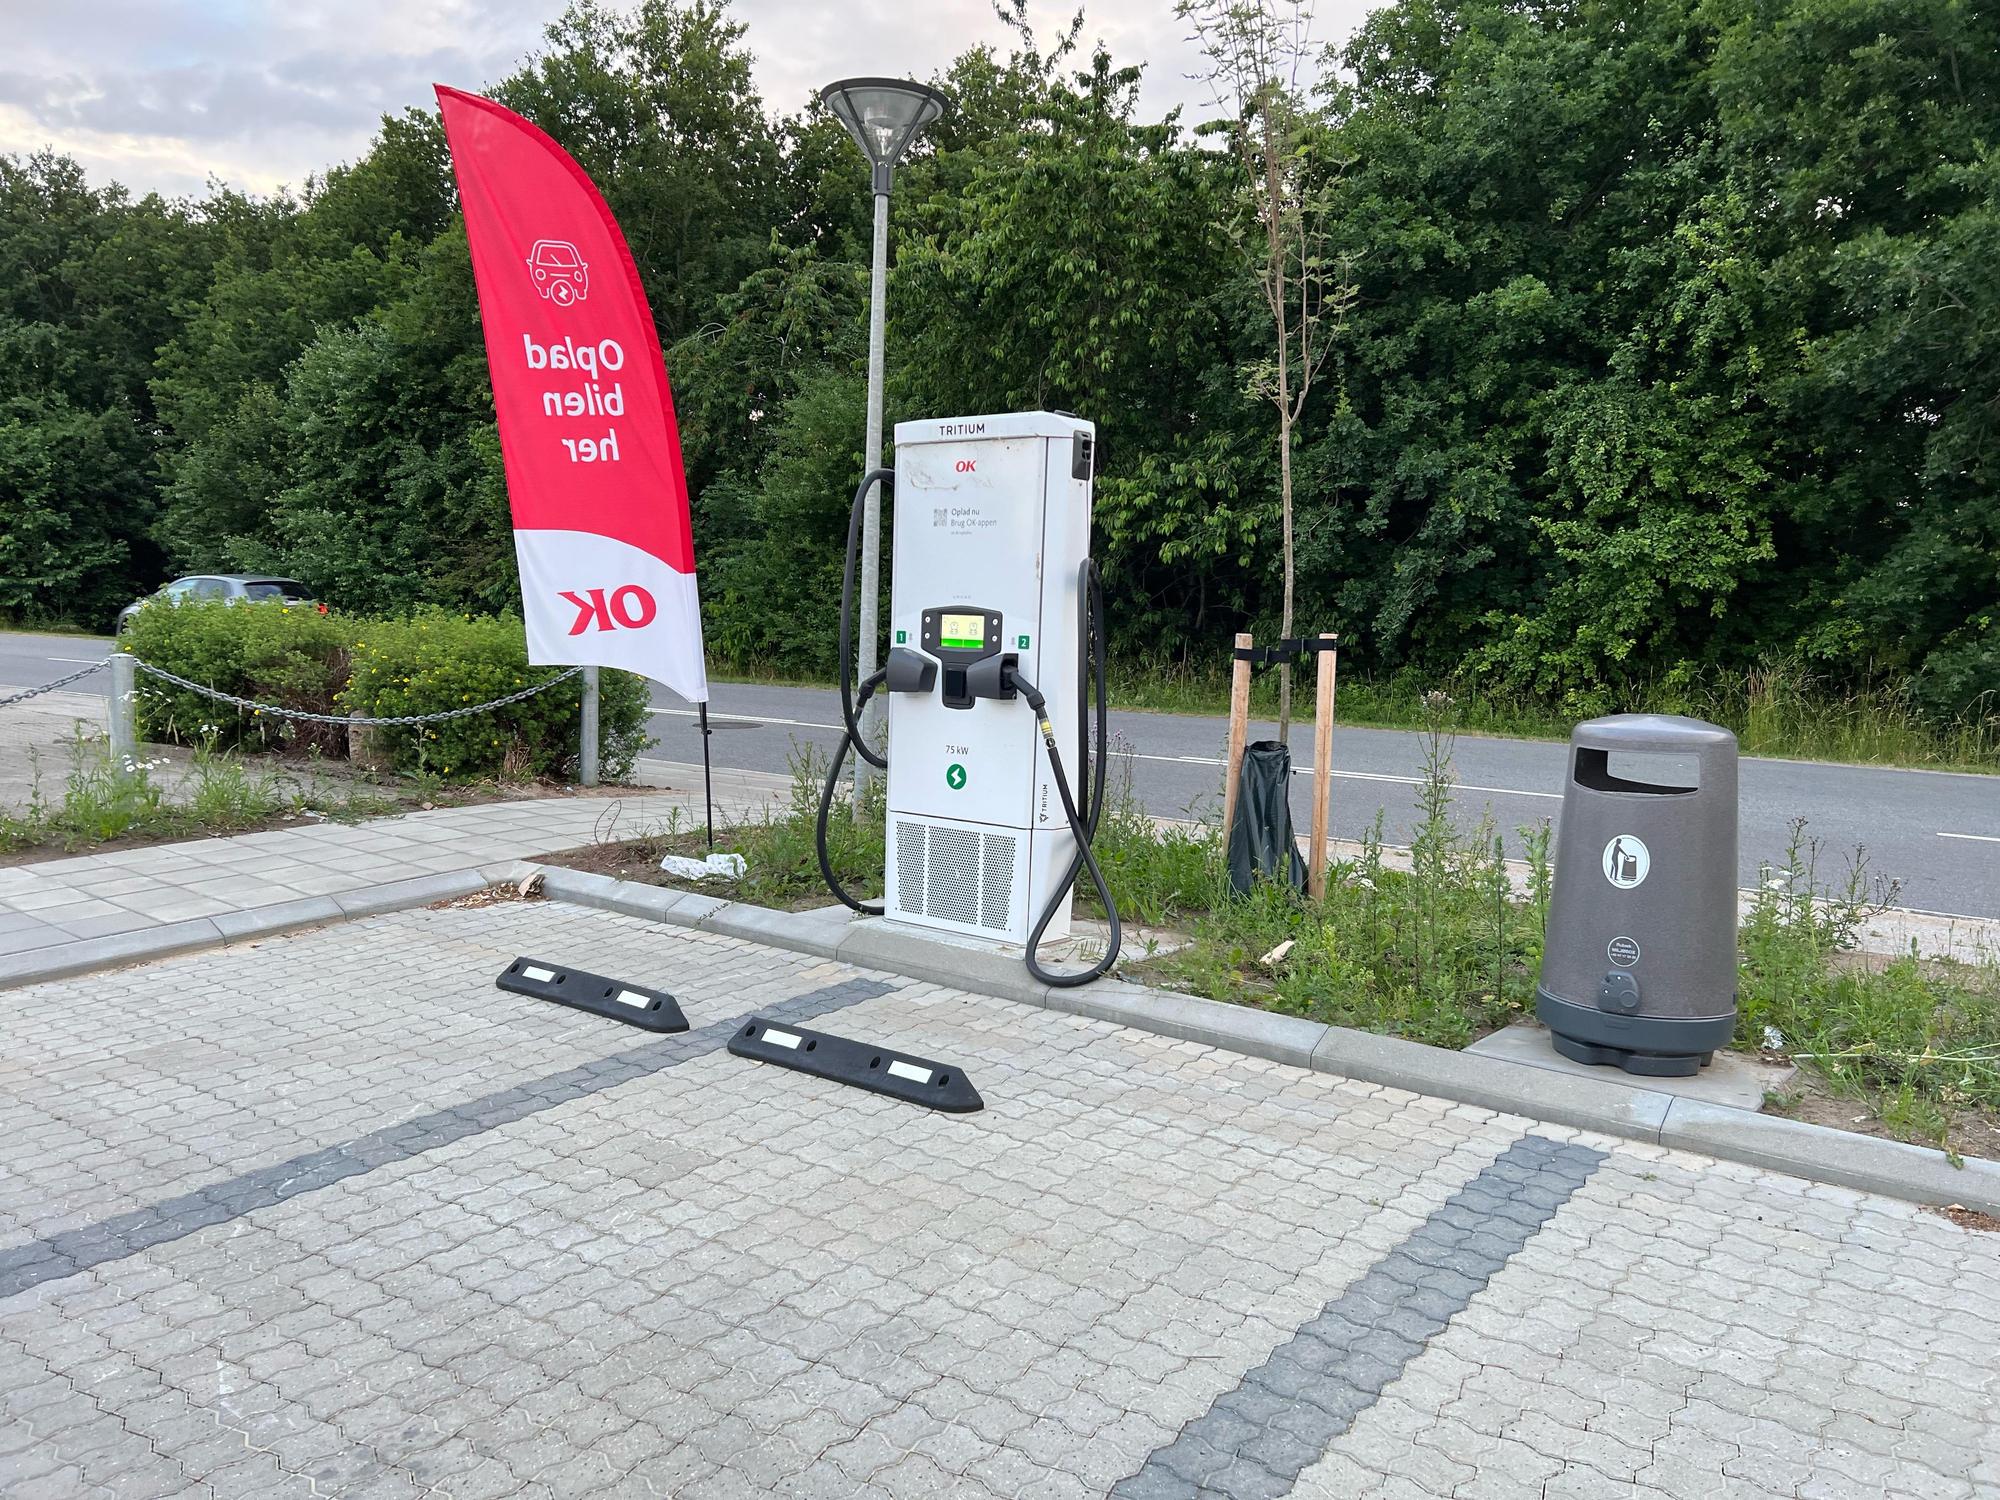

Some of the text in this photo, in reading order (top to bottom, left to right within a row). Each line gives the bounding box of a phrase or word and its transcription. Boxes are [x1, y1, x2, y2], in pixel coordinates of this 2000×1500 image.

[939, 423, 985, 436] TRITIUM
[955, 460, 977, 473] OK
[951, 508, 971, 517] Oplad
[951, 519, 965, 528] Brug
[945, 745, 969, 755] 75 kW
